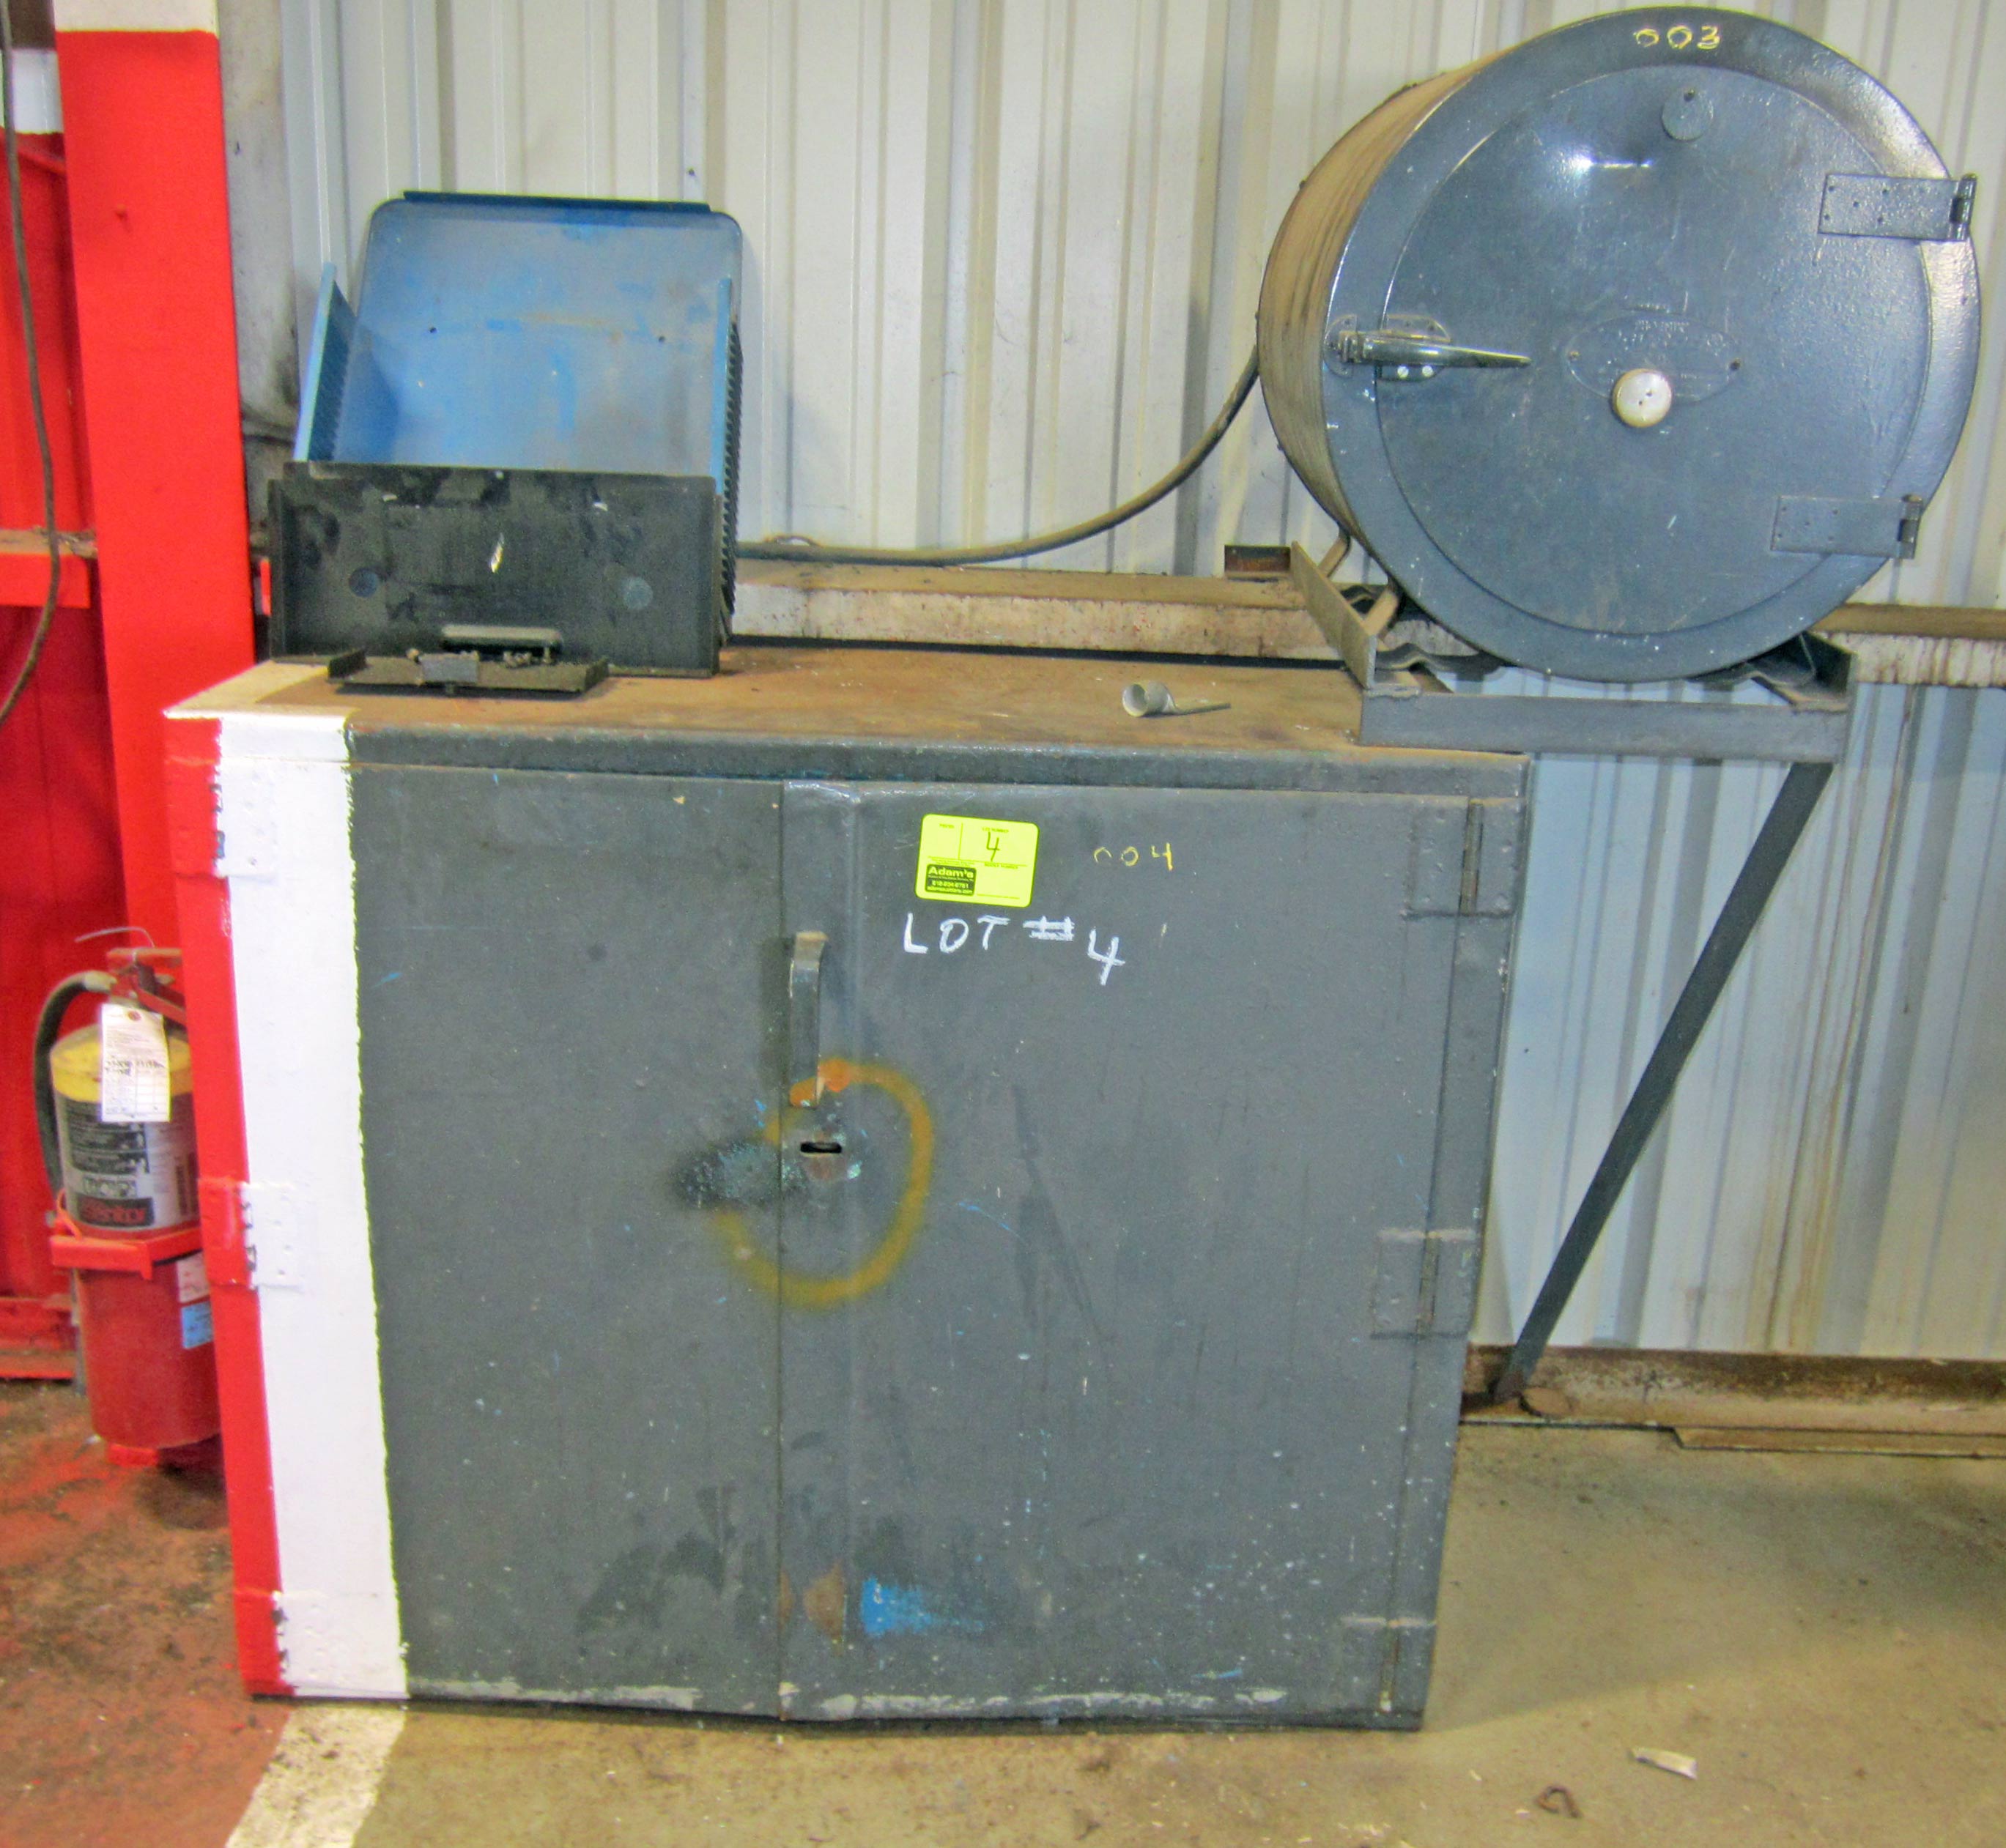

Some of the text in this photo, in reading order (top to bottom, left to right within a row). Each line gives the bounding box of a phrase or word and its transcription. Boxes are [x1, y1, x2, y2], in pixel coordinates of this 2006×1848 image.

[1633, 25, 1721, 50] 003
[986, 831, 1001, 862] 4
[928, 867, 974, 880] Adam's
[903, 913, 1011, 954] LOT
